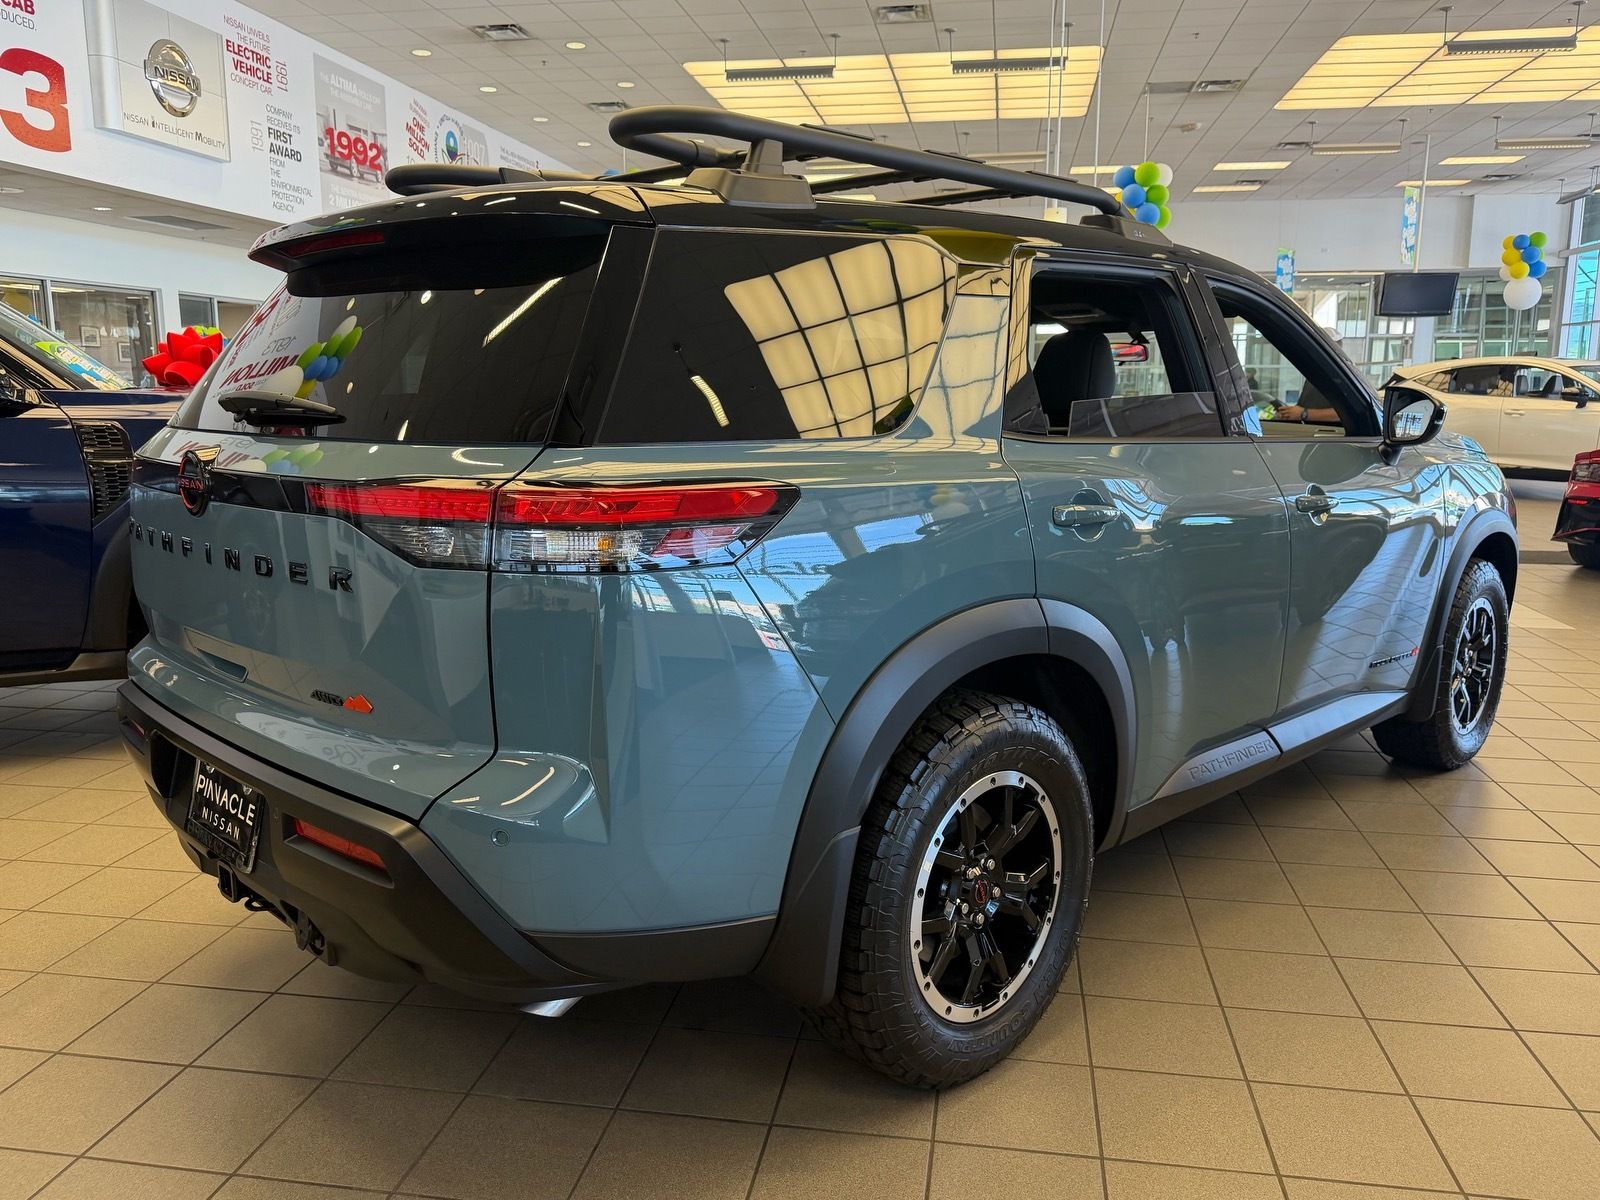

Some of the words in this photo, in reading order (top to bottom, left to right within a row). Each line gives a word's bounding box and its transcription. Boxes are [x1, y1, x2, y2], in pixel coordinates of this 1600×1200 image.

[0, 9, 37, 31] DUCED.
[223, 14, 246, 32] NISSAN
[247, 26, 270, 44] UNVEILS
[225, 39, 272, 69] ELECTRIC
[236, 32, 248, 45] THE
[249, 38, 271, 55] FUTURE
[154, 65, 199, 92] NISSAN
[230, 72, 259, 91] CONCEPT
[232, 57, 273, 85] VEHICLE
[330, 73, 359, 96] ALTIMA
[123, 112, 149, 127] NISSAN
[265, 103, 293, 121] COMPANY
[266, 115, 292, 132] RECEIVES
[412, 116, 426, 137] ONE
[267, 126, 293, 146] FIRST
[405, 122, 430, 153] MILLION
[269, 142, 302, 163] AWARD
[325, 127, 383, 173] 1992
[269, 156, 286, 168] FROM
[270, 167, 282, 179] THE
[271, 178, 313, 198] ENVIRONMENTAL
[271, 189, 305, 206] PROTECTION
[128, 516, 353, 593] PATHFINDER
[1188, 738, 1275, 782] PATHFINDER
[201, 806, 241, 841] NISSAN
